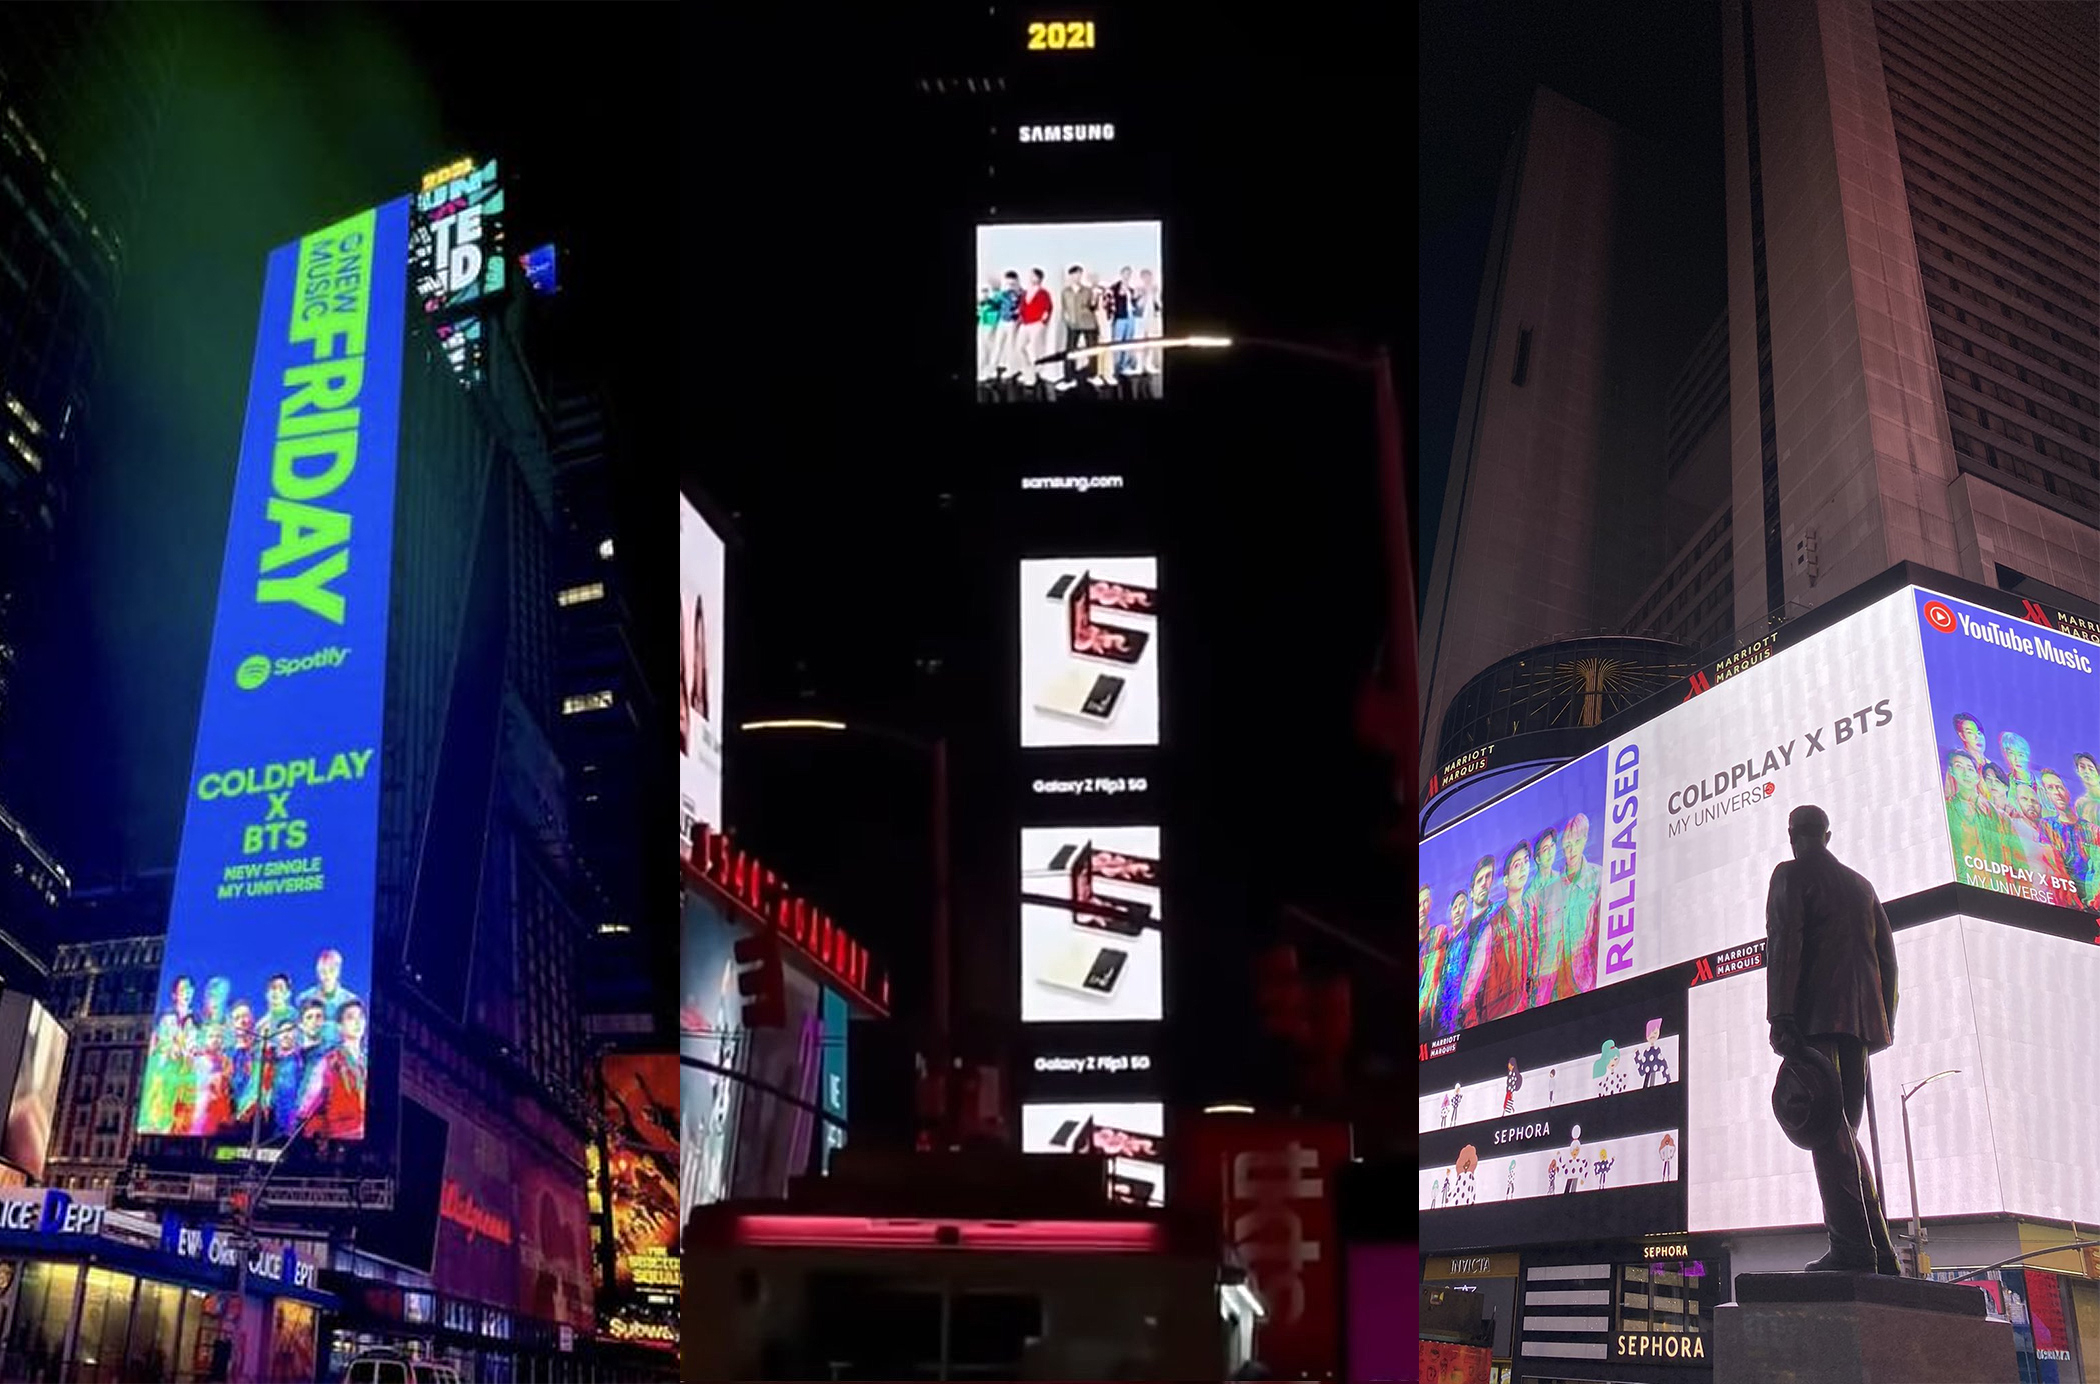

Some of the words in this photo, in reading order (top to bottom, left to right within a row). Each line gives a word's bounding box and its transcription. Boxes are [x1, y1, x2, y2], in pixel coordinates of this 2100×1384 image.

[1027, 21, 1096, 50] 2021
[1019, 123, 1115, 142] SAMSUNG
[301, 238, 333, 322] MUSIC
[332, 253, 362, 315] NEW
[255, 322, 366, 627] FRIDAY
[1022, 475, 1124, 492] samsung.com
[2057, 611, 2100, 634] MARRI
[1716, 632, 1778, 672] MARRIOTT
[1957, 611, 2034, 657] YouTube
[2034, 636, 2092, 674] Music
[274, 646, 349, 677] Spotify
[1716, 648, 1771, 684] MARQUIS
[1443, 745, 1495, 775] MARRIOTT
[1667, 739, 1796, 815] COLDPLAY
[1805, 727, 1826, 758] X
[1834, 699, 1894, 745] BTS
[197, 749, 374, 801] COLDPLAY
[1442, 759, 1486, 787] MARQUIS
[265, 791, 291, 821] X
[1668, 815, 1691, 838] MY
[1694, 782, 1772, 828] UNIVERSE
[243, 819, 308, 855] BTS
[223, 864, 263, 883] NEW
[264, 857, 322, 876] SINGLE
[1605, 743, 1640, 975] RELEASED
[217, 883, 245, 900] MY
[246, 875, 325, 897] UNIVERSE
[1964, 855, 2036, 883] COLDPLAY
[2038, 873, 2048, 887] X
[2050, 876, 2078, 894] BTS
[1966, 873, 1987, 890] MY
[1989, 879, 2056, 906] UNIVERSE
[1717, 942, 1766, 965] MARRIOTT
[1717, 955, 1760, 975] MARQUIS
[1430, 1044, 1457, 1058] MARQUIS
[1431, 1034, 1461, 1049] MARRIOTT
[1494, 1121, 1550, 1145] SEPHORA
[0, 1198, 32, 1230] ICE
[1449, 1256, 1491, 1275] INVICTA
[1643, 1244, 1689, 1259] SEPHORA
[1617, 1335, 1705, 1359] SEPHORA
